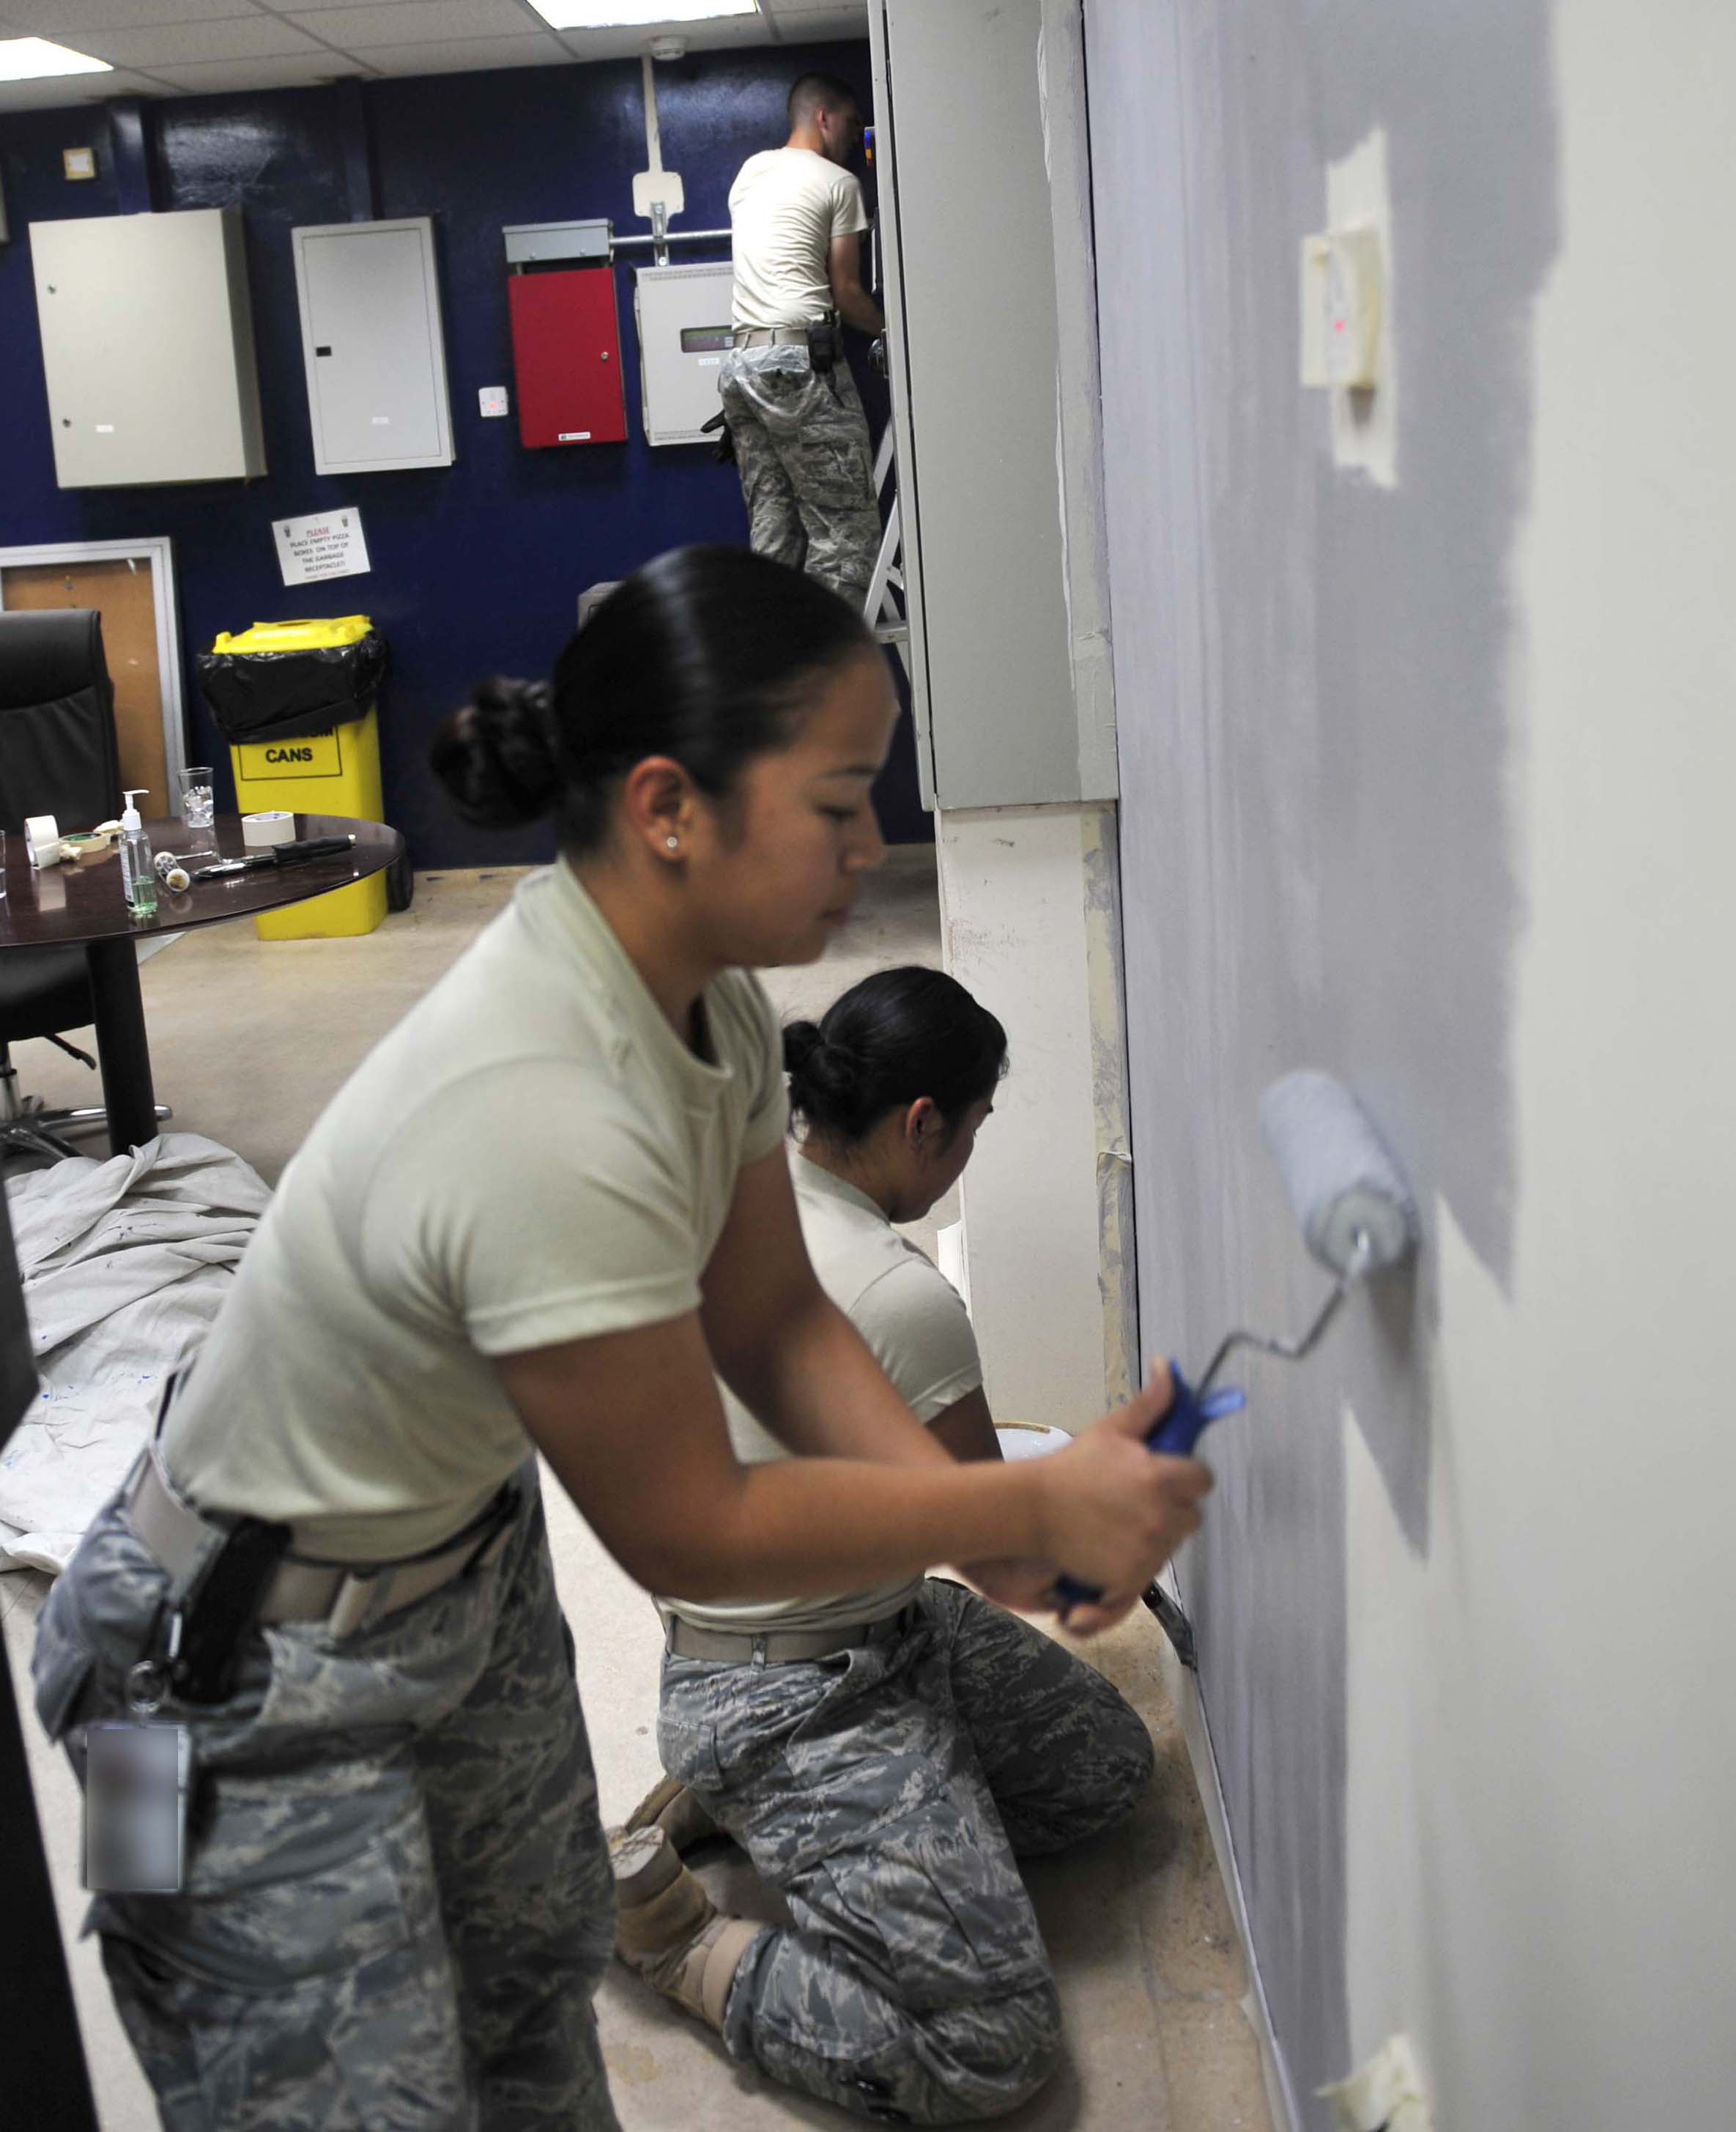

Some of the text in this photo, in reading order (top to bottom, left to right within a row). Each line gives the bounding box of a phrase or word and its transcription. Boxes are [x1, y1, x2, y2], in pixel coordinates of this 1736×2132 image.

[306, 527, 330, 538] PLEASE
[289, 539, 308, 547] PLACE
[310, 536, 330, 544] EMPTY
[294, 548, 313, 557] BOXES
[314, 552, 344, 561] GARBAGE
[266, 747, 313, 763] CANS
